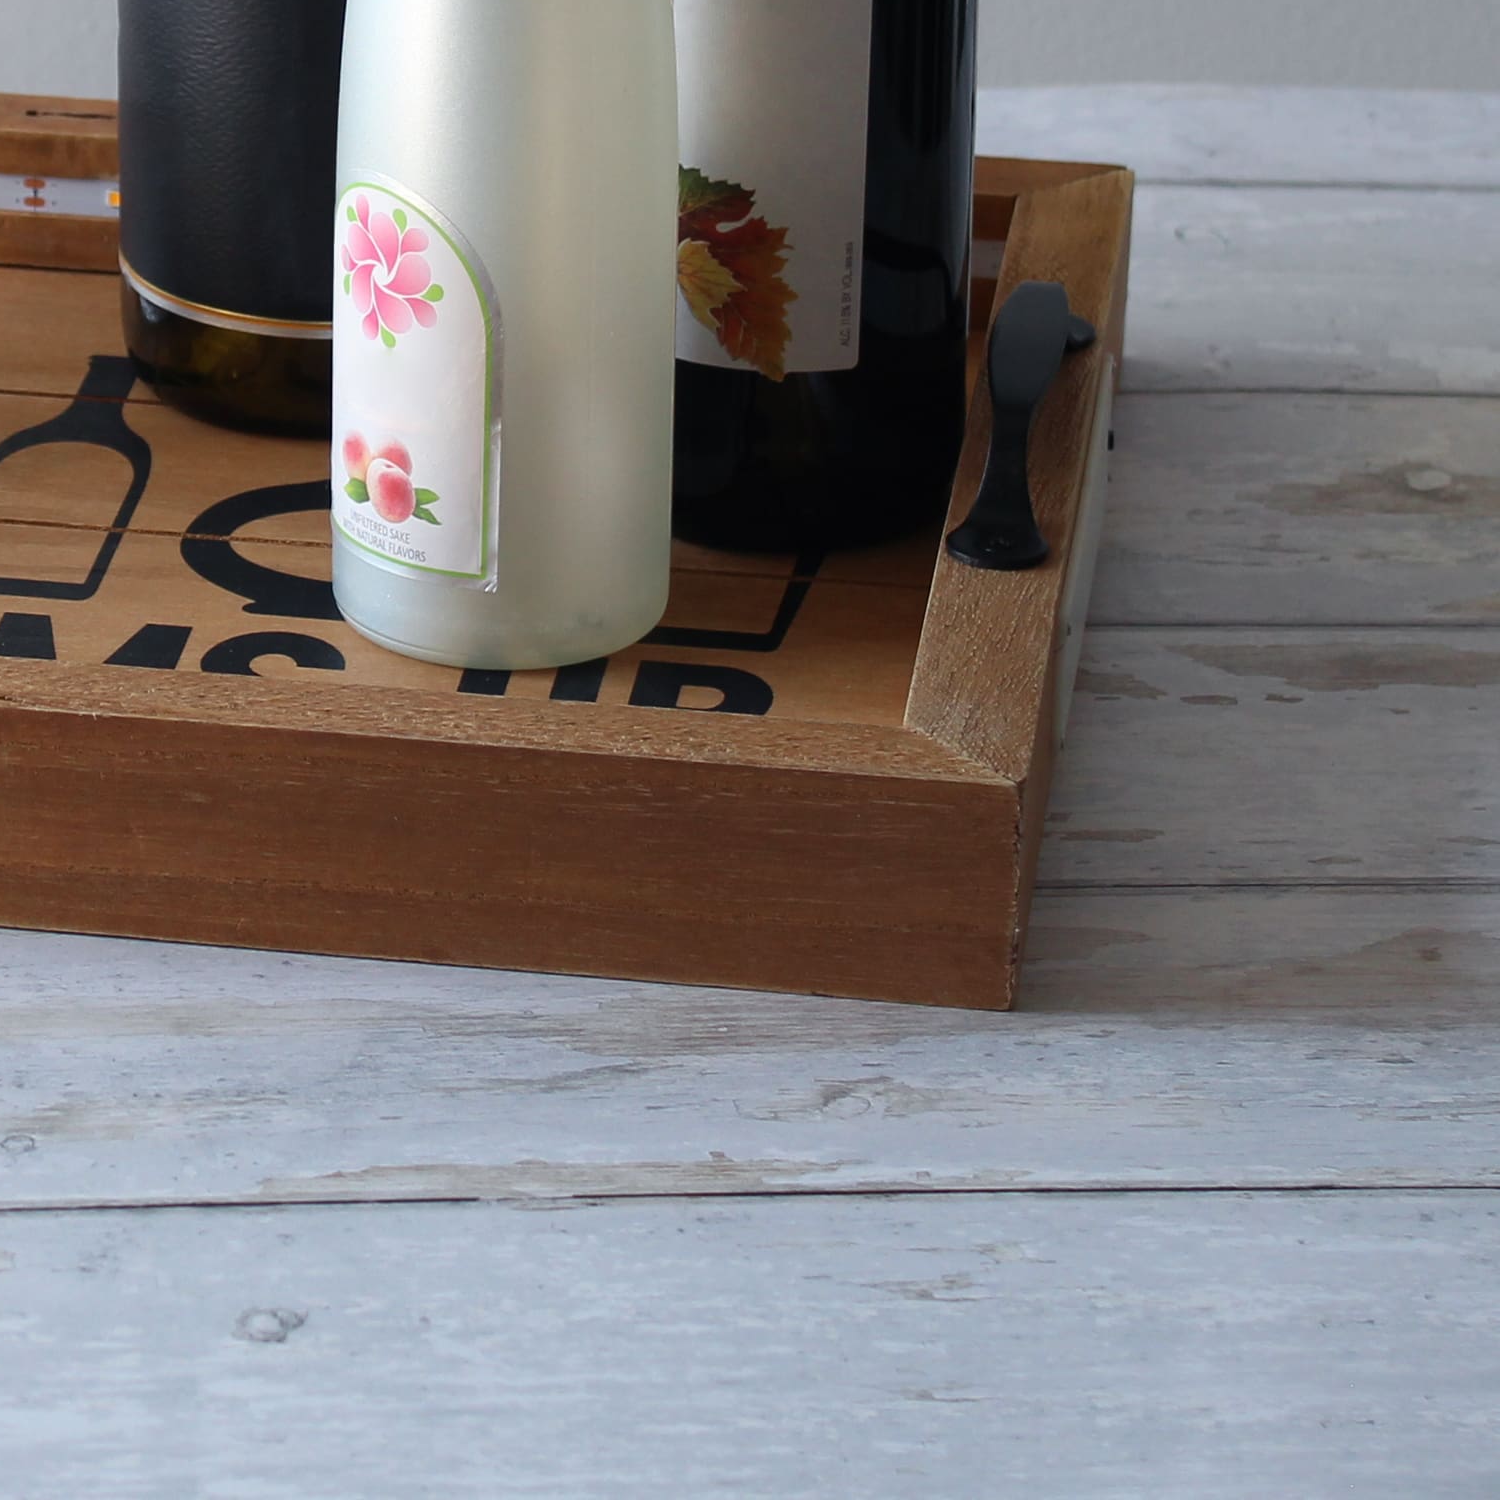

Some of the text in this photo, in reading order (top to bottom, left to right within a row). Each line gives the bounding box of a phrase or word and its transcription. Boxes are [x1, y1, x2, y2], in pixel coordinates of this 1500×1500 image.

[356, 527, 387, 551] NATURAL
[388, 541, 427, 563] FLAVORS
[389, 528, 411, 544] SAKE
